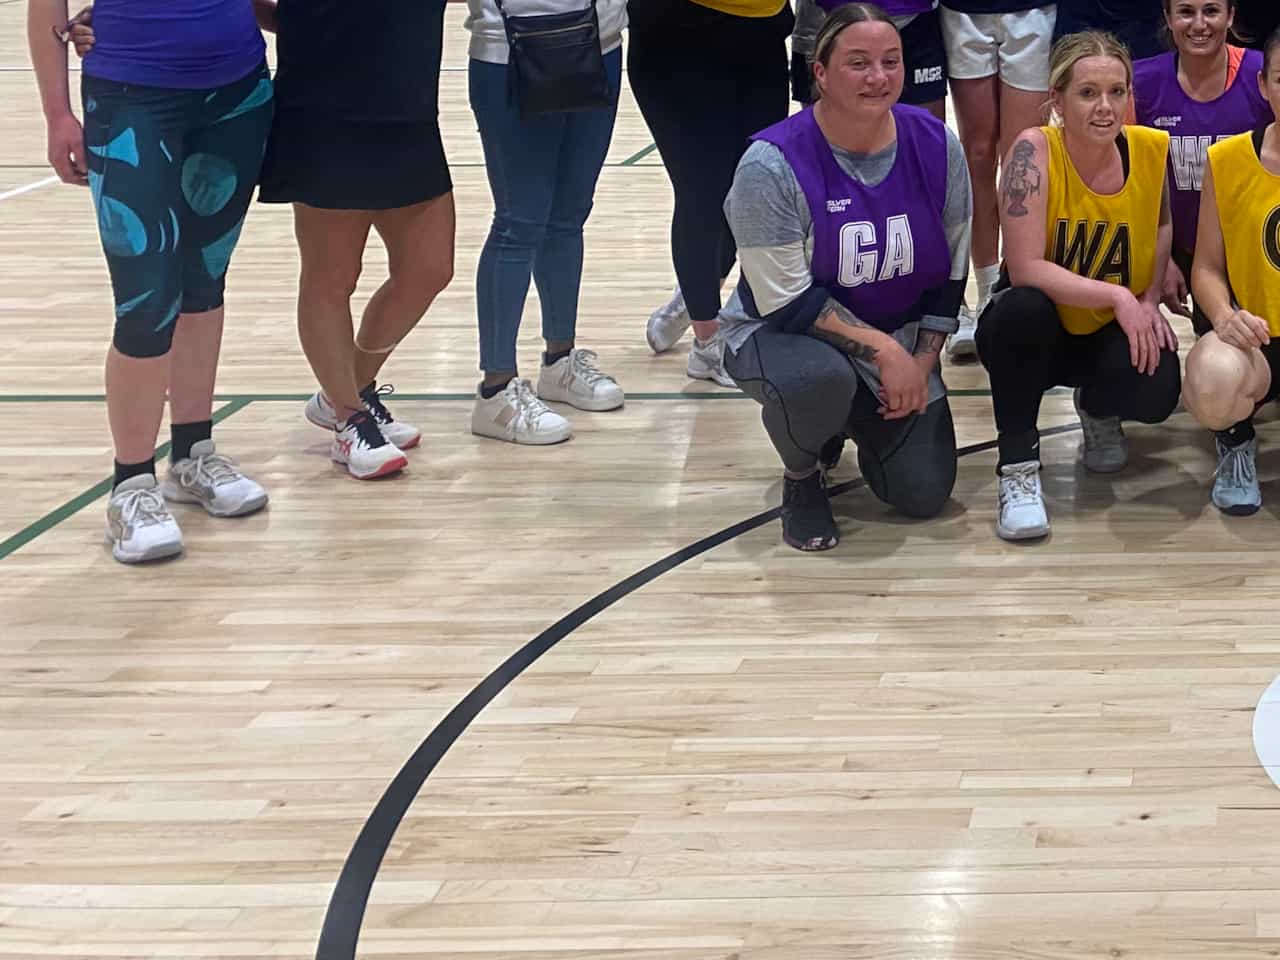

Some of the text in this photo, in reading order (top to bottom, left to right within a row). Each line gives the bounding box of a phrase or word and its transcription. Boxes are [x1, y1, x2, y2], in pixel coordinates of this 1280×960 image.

[1169, 135, 1235, 191] W
[837, 213, 915, 288] GA
[1052, 218, 1131, 285] WA
